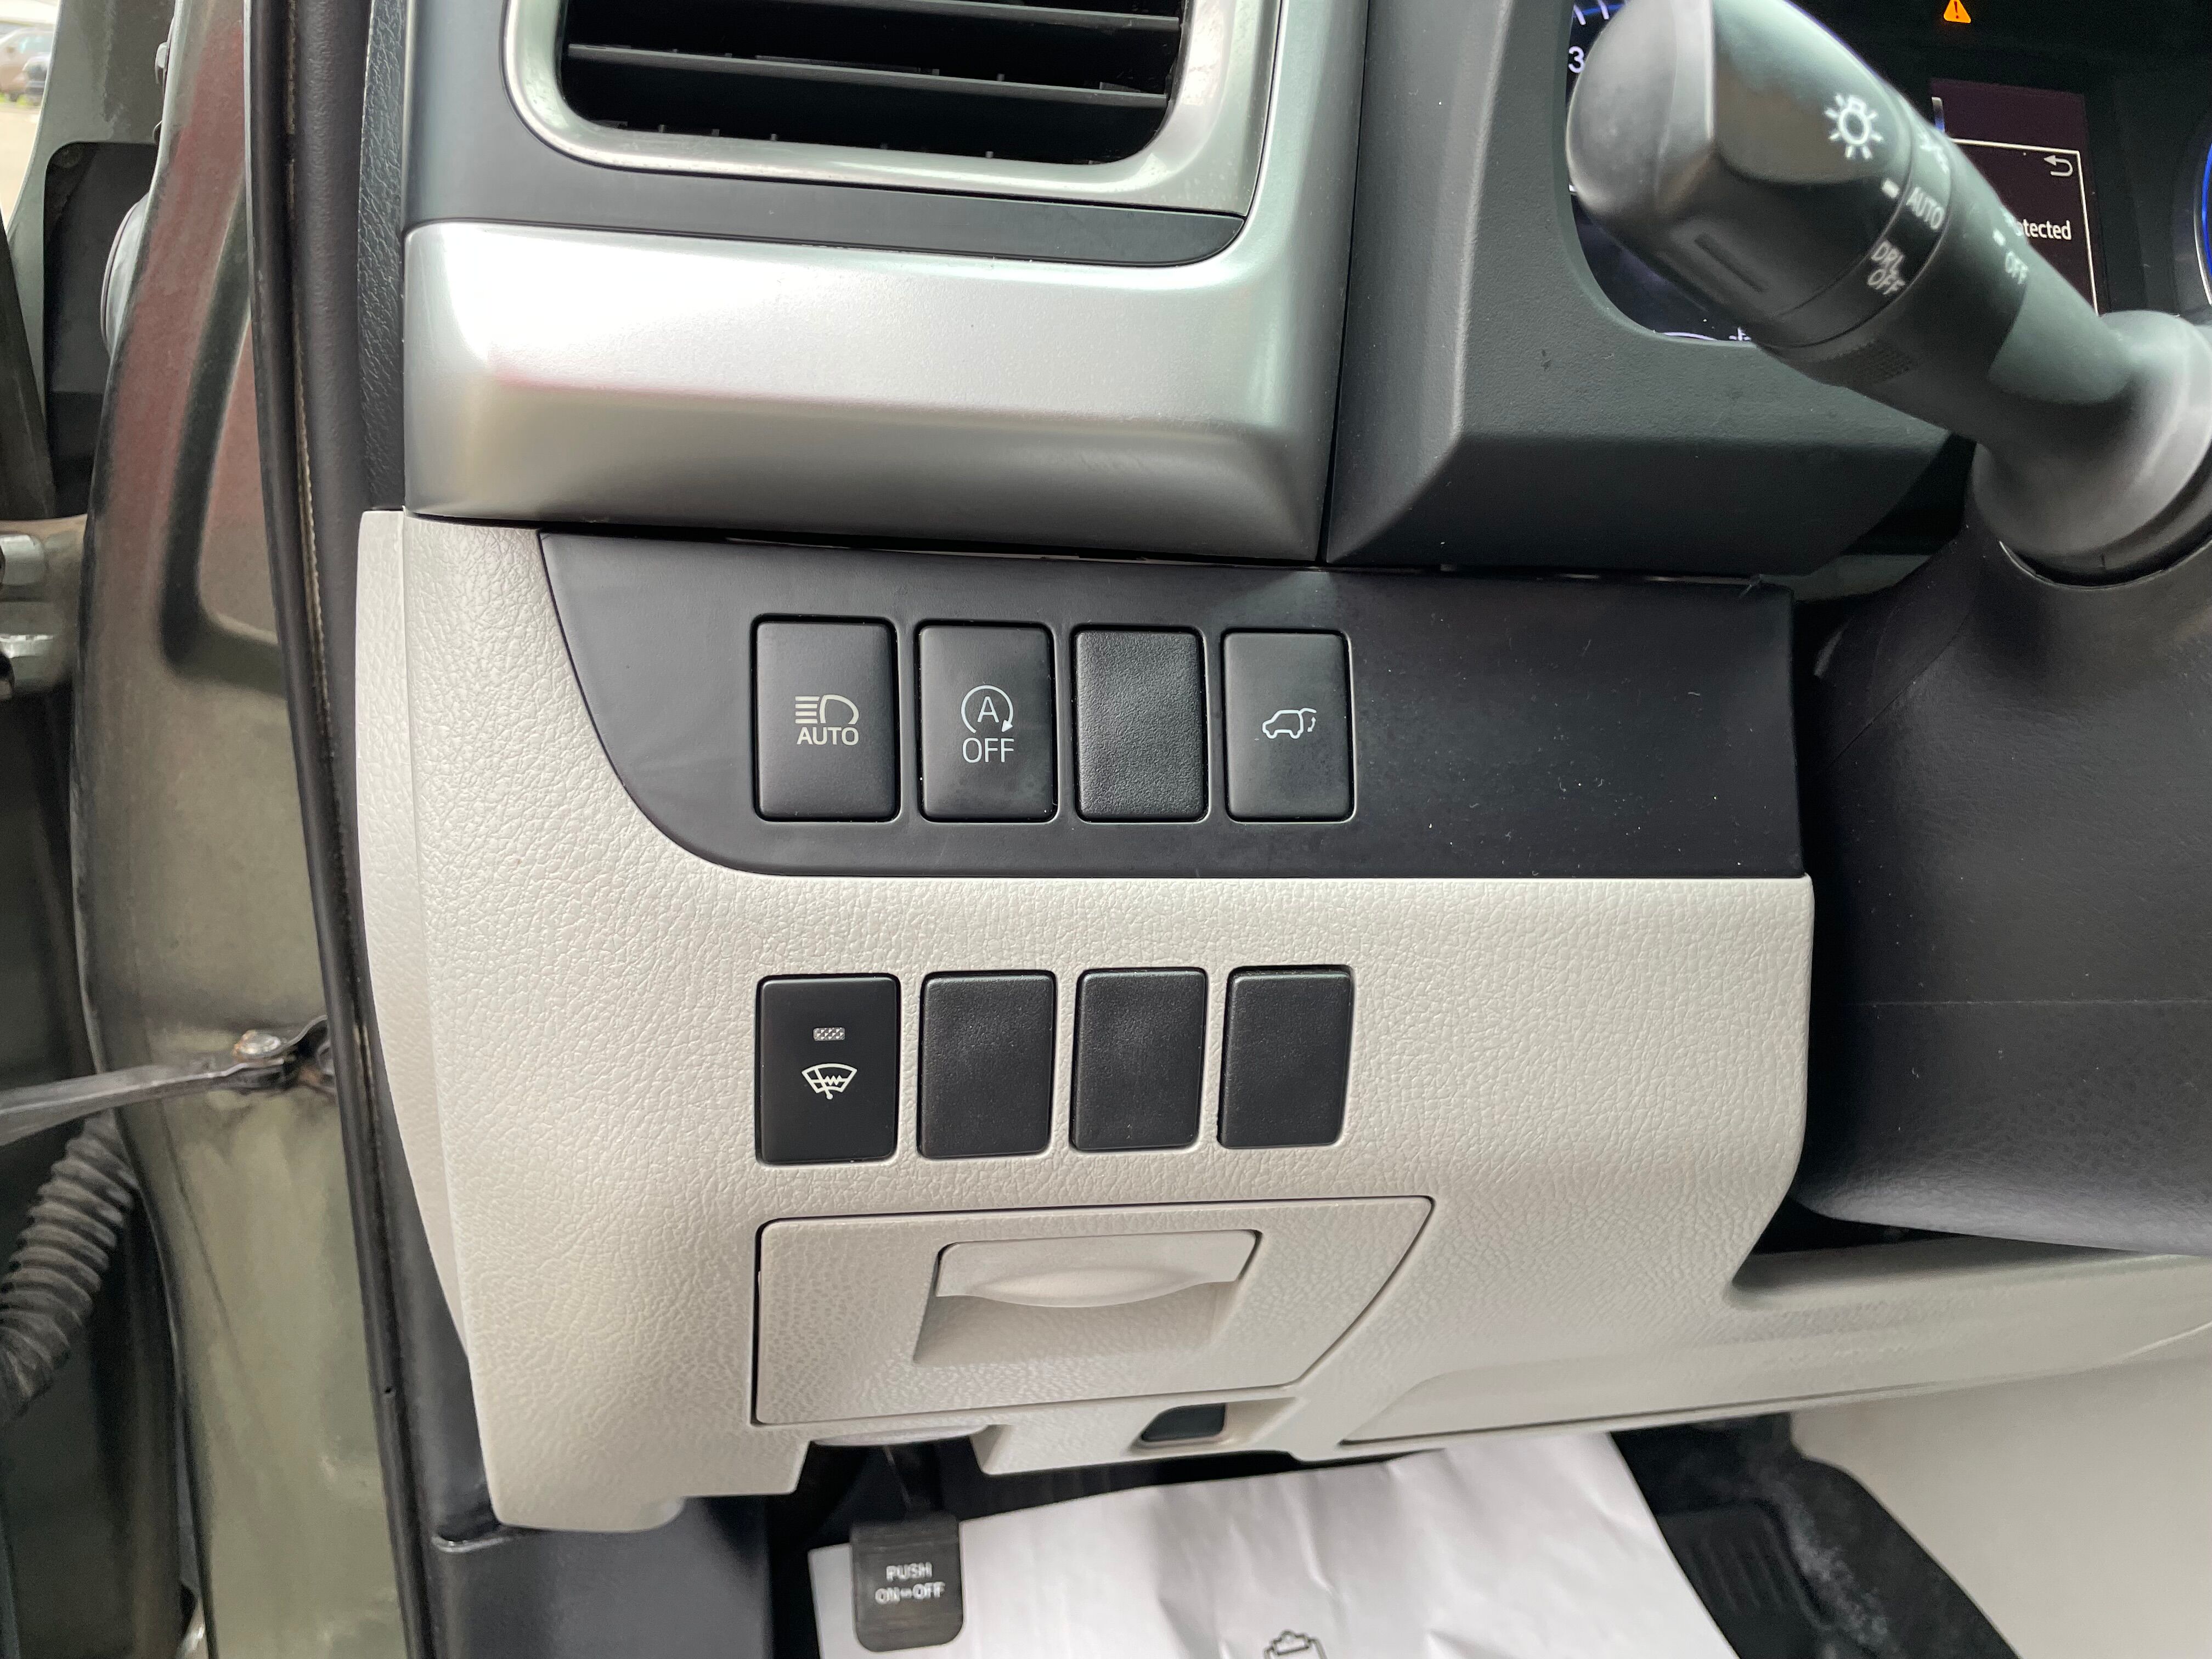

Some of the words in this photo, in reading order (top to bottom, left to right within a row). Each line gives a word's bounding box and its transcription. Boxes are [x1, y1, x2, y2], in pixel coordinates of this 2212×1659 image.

[1568, 46, 1584, 74] 3
[1906, 187, 1945, 231] AUTO
[1871, 240, 1905, 269] DRL
[2005, 251, 2029, 285] OFF
[1867, 269, 1906, 295] OFF
[796, 726, 860, 746] AUTO
[962, 737, 1014, 763] OFF
[886, 1561, 933, 1581] PUSH
